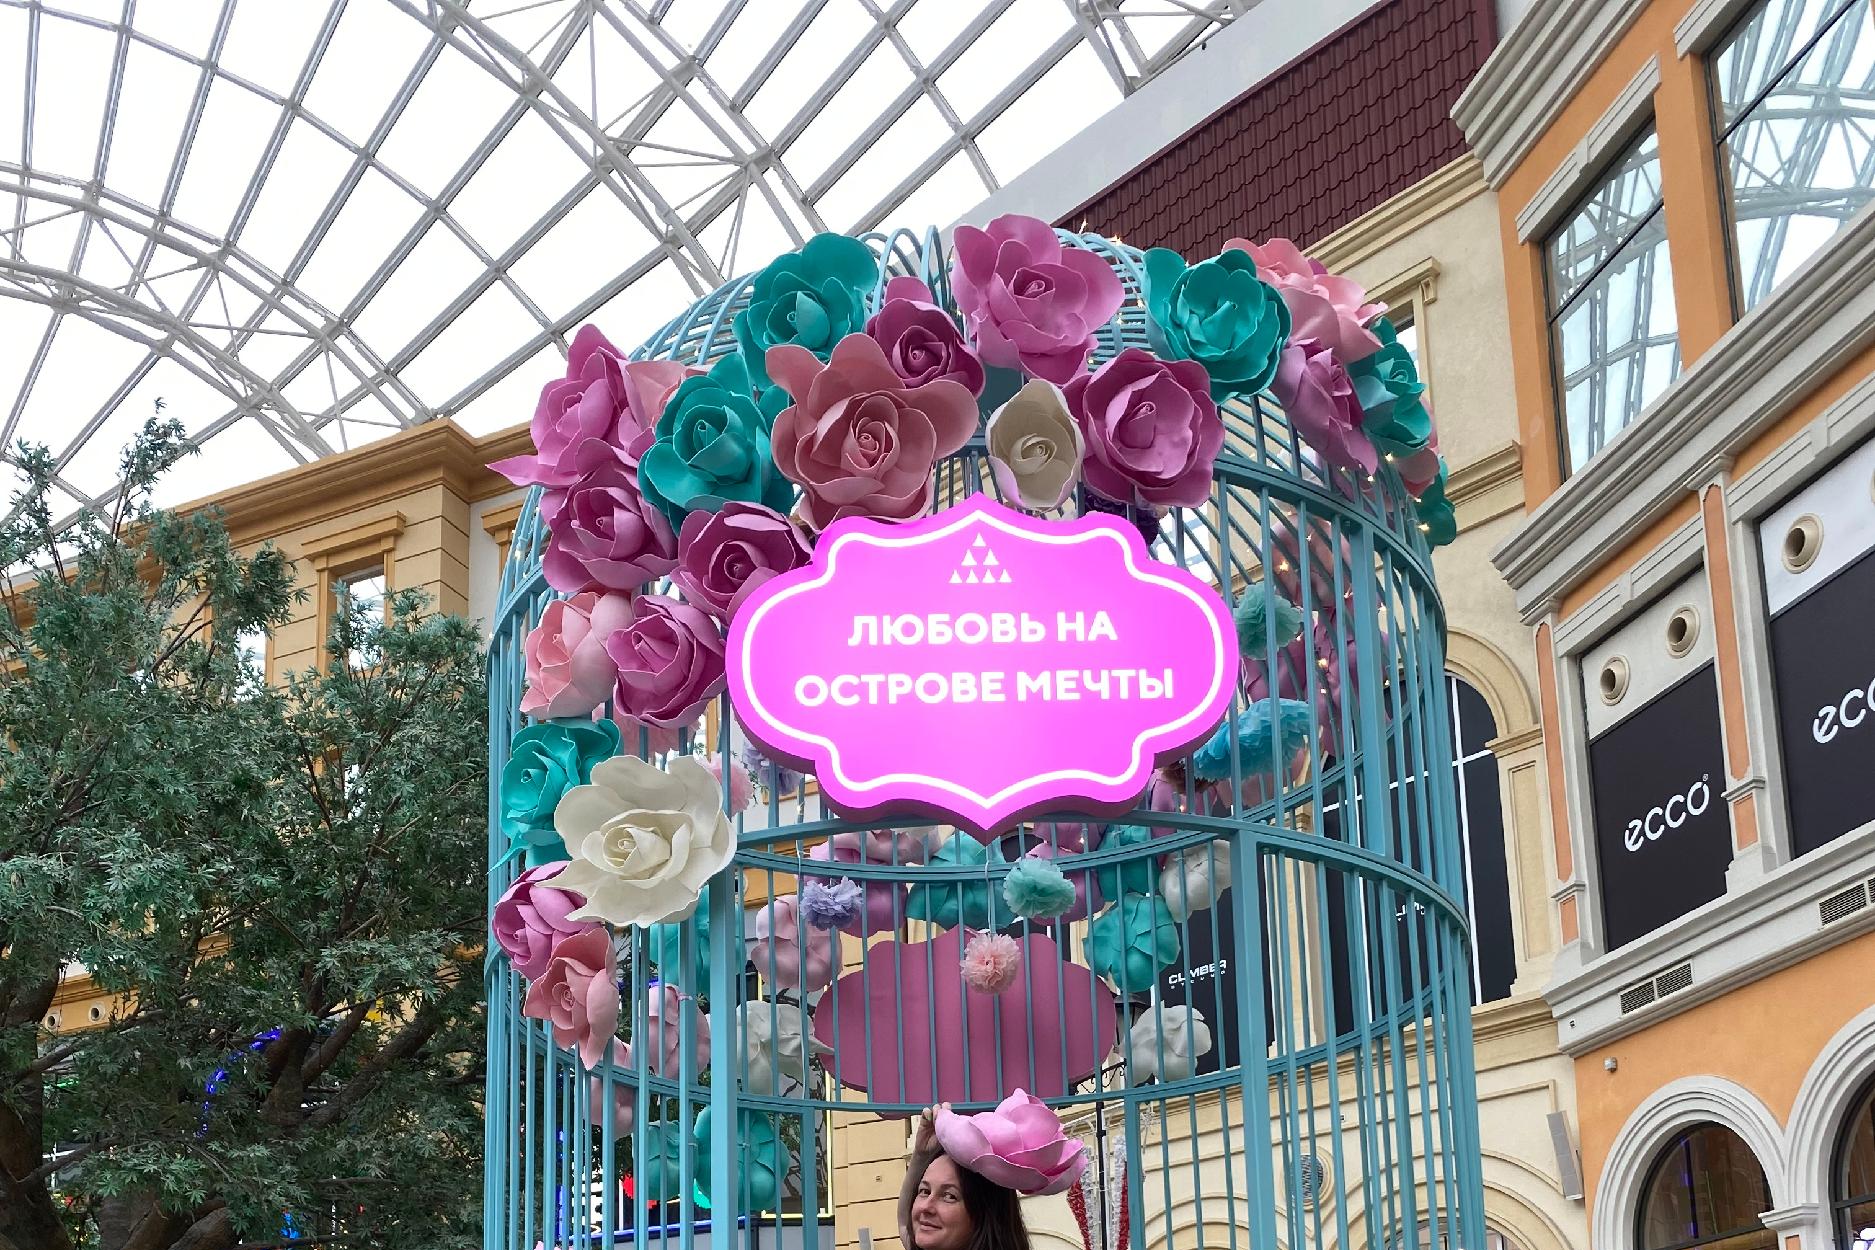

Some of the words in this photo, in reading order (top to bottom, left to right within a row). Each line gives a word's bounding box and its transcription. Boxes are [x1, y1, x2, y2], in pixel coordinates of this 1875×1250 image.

[848, 612, 1045, 646] ЛЮБОВЬ
[1057, 610, 1118, 642] НА
[794, 671, 1005, 706] ОСТРОВЕ
[1017, 668, 1174, 700] МЕЧТЫ
[1812, 677, 1875, 744] ec
[1168, 959, 1227, 984] CLMBER
